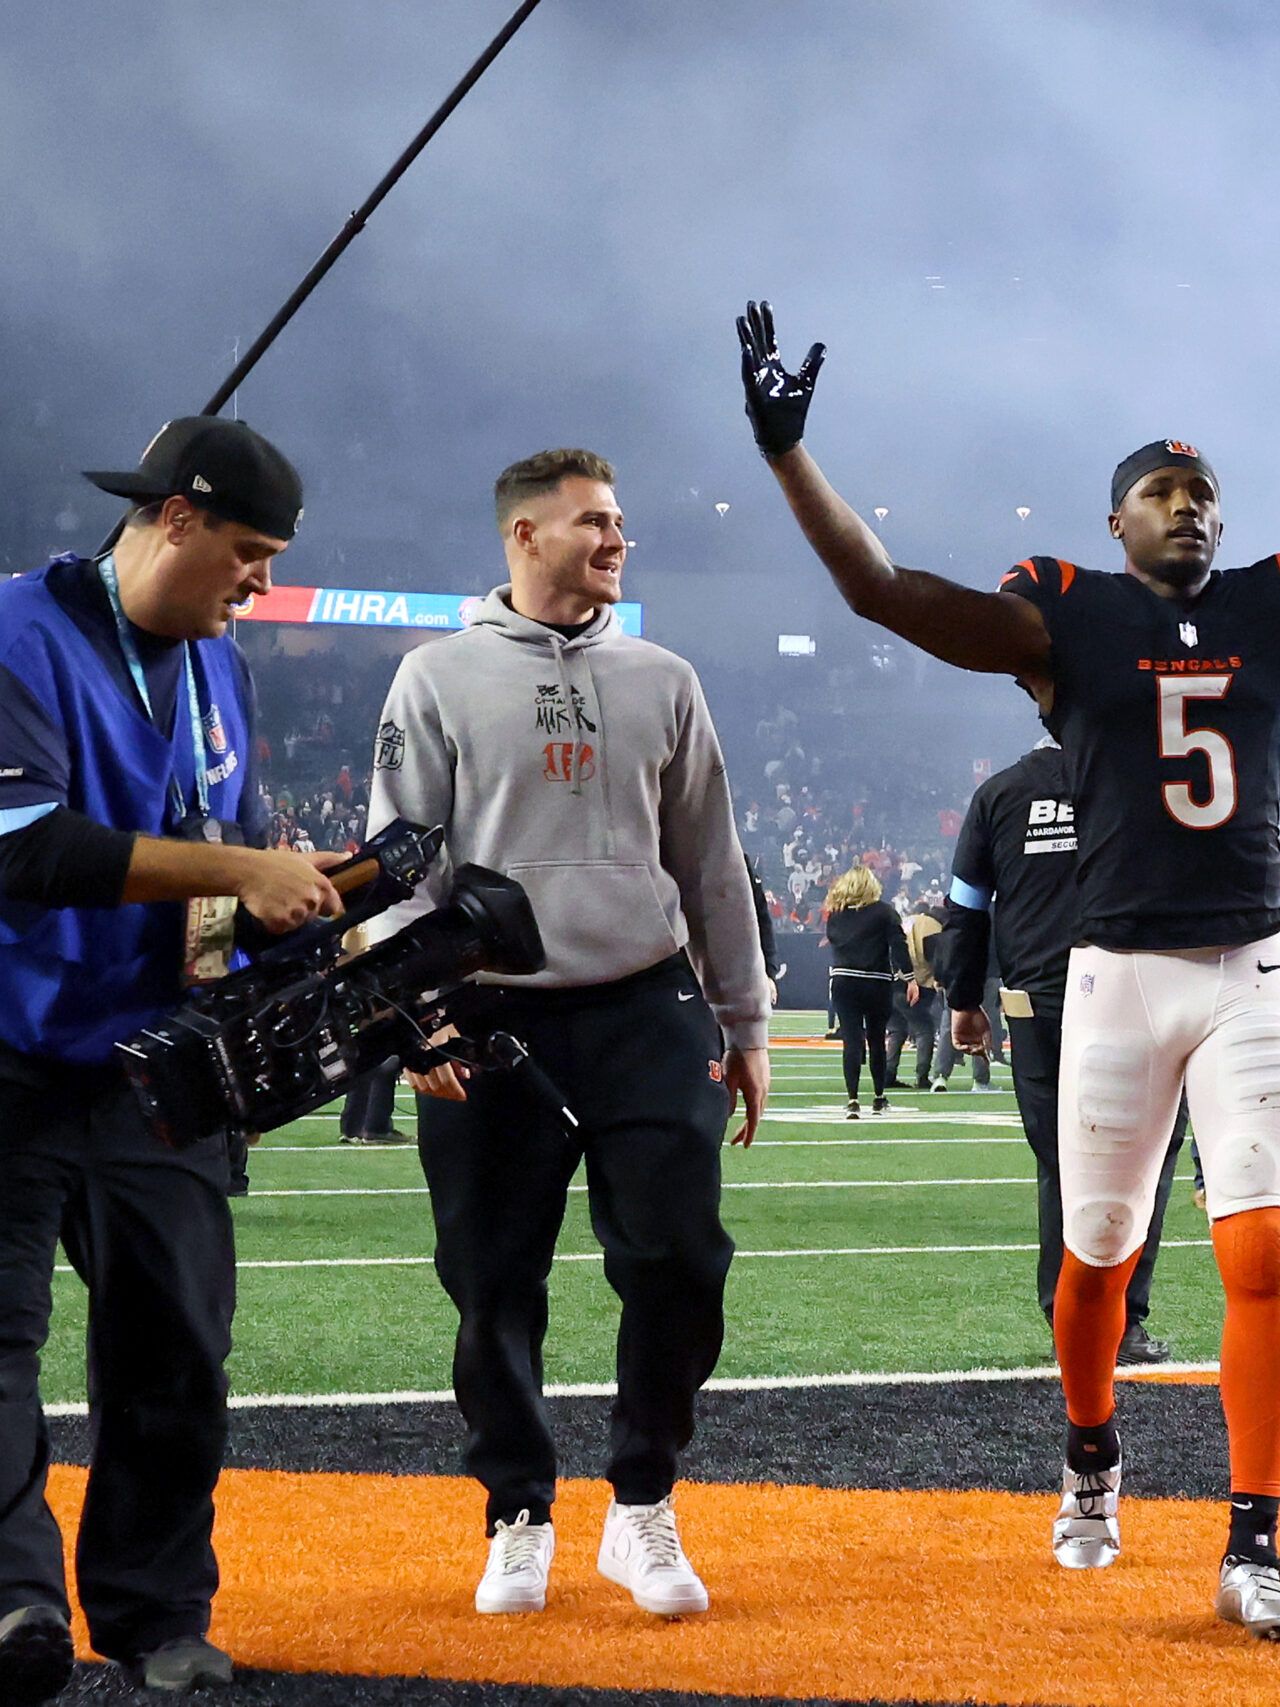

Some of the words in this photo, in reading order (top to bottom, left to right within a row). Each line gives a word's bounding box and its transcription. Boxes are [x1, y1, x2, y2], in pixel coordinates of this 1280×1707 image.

[1136, 656, 1242, 671] BENGALS
[1155, 673, 1239, 830] 5
[1028, 799, 1075, 825] BE
[1033, 826, 1076, 837] GARDAWOR
[1051, 841, 1078, 849] SECU
